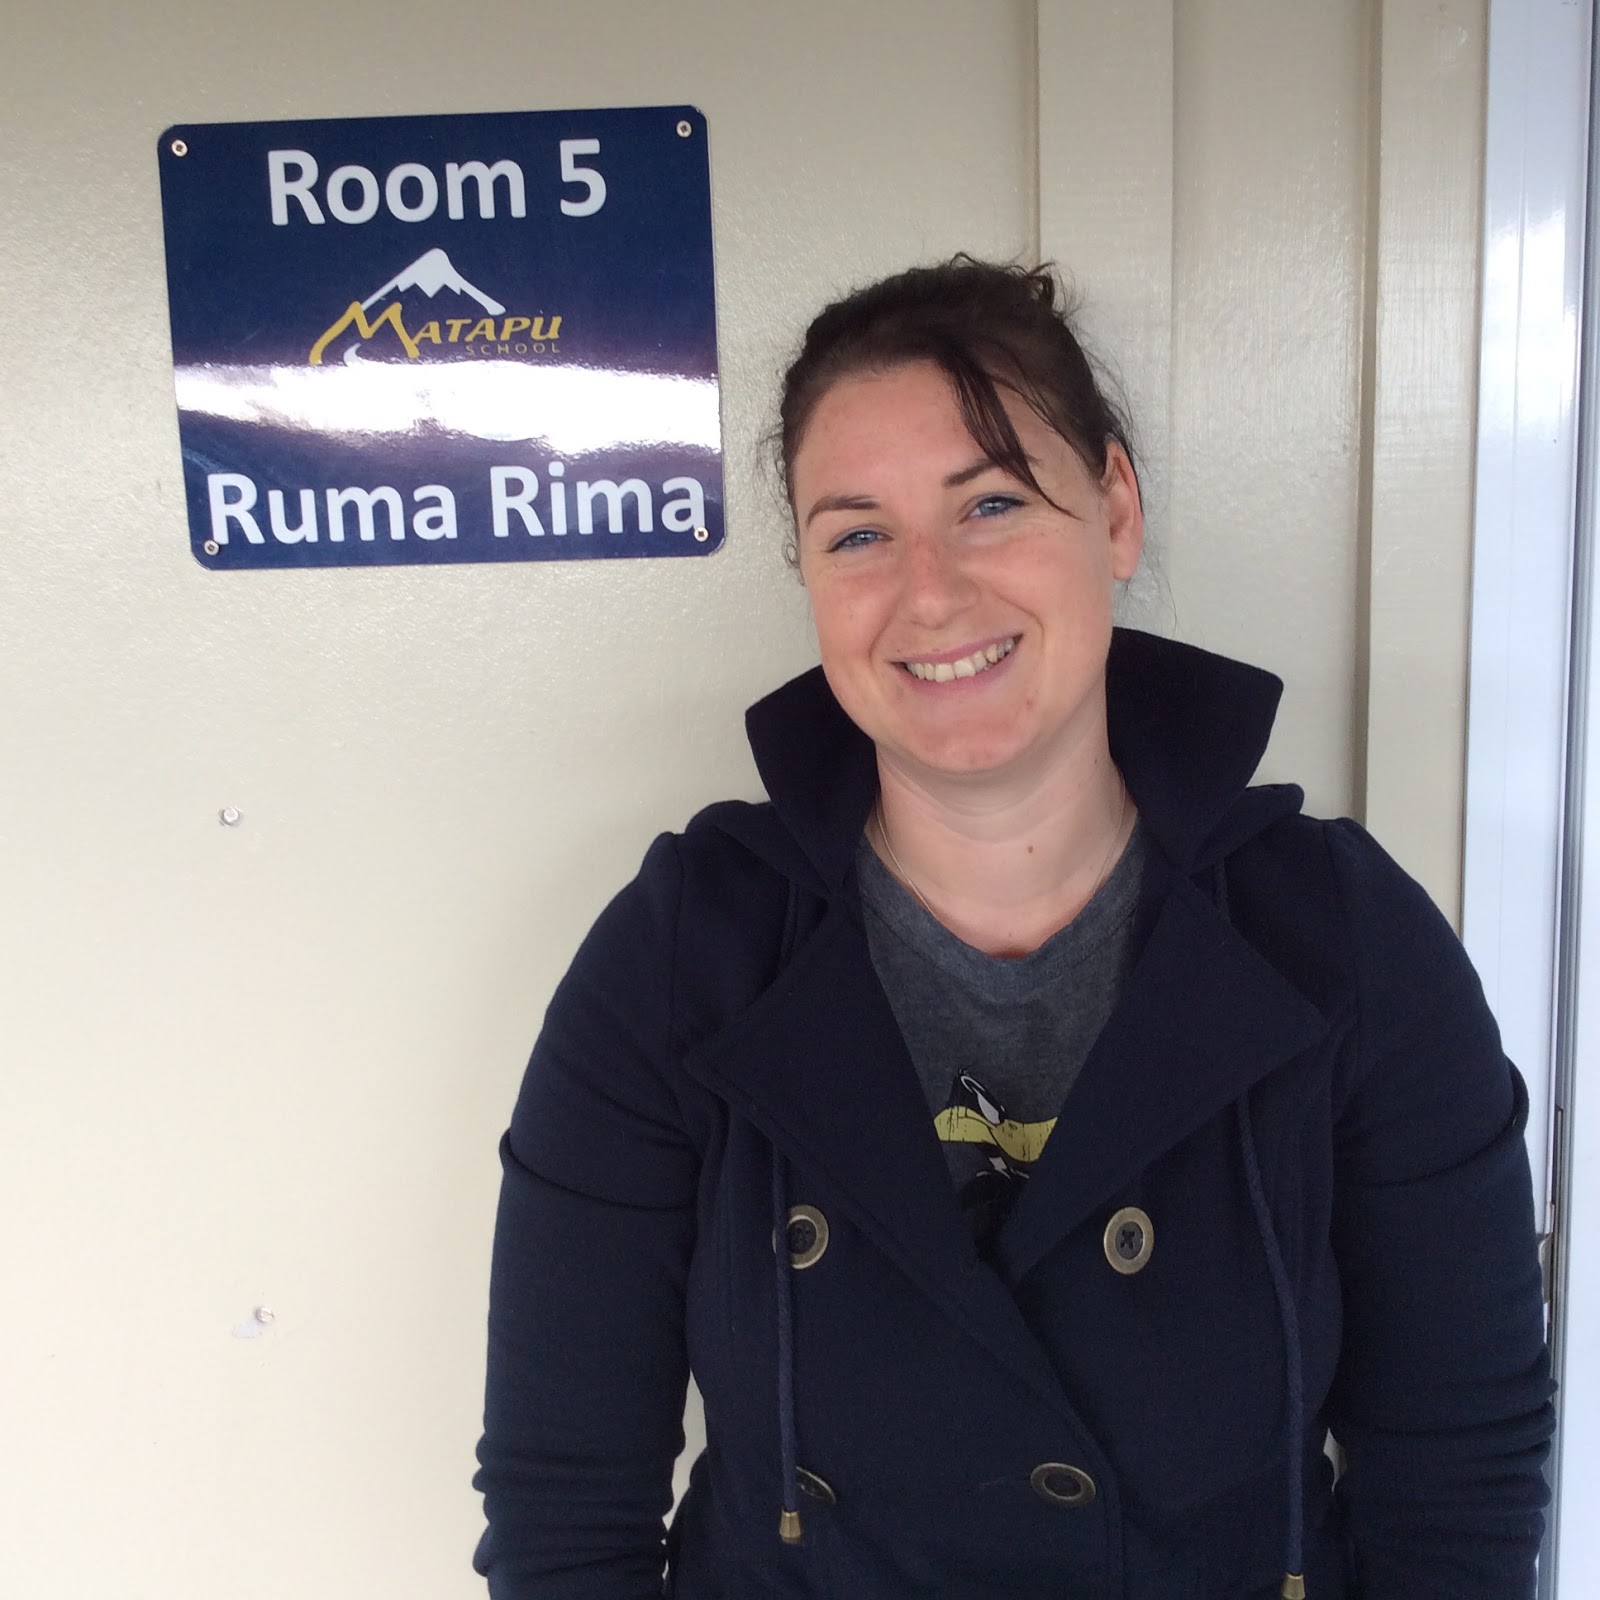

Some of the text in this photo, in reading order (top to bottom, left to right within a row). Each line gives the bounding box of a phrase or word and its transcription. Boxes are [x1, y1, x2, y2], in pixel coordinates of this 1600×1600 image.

[267, 138, 607, 226] Room 5
[309, 301, 562, 365] MATAPU
[465, 342, 561, 356] SCHOOL
[207, 462, 706, 545] Ruma Rima
